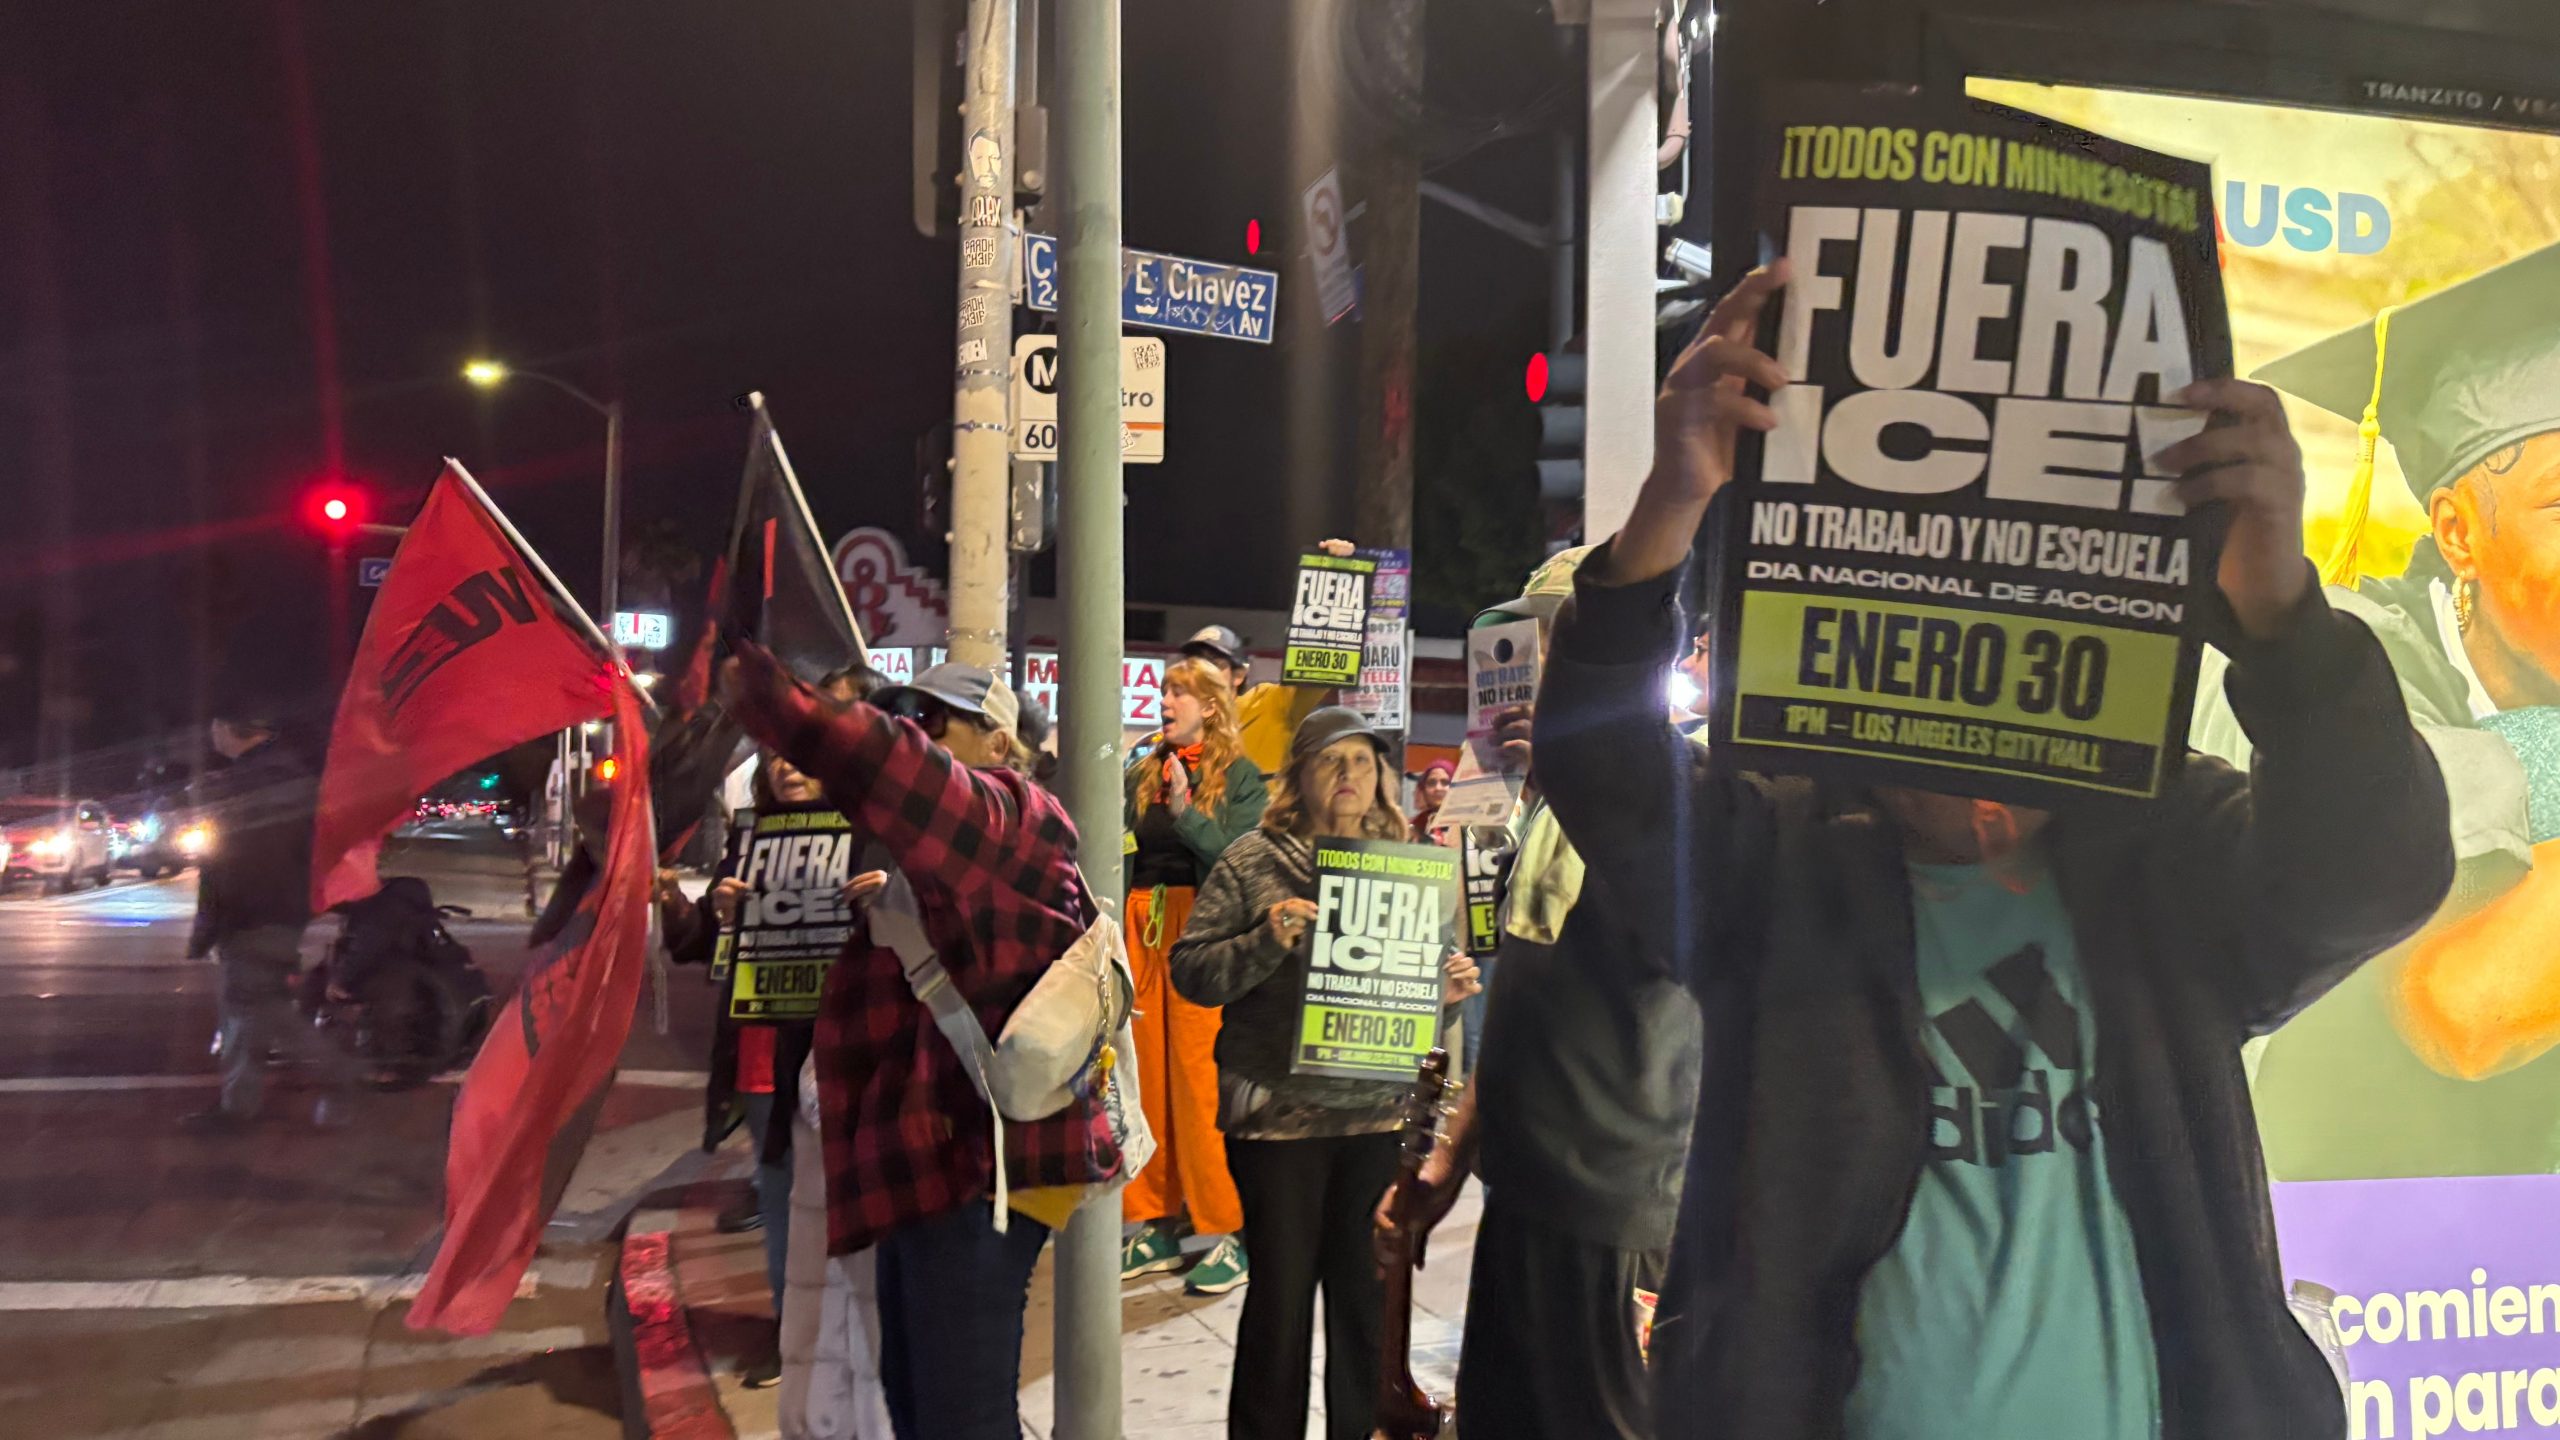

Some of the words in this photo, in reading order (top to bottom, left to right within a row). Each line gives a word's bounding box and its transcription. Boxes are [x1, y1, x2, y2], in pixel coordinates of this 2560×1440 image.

[2363, 81, 2483, 109] TRANZITO
[1780, 125, 1917, 180] ¡TODOS
[1920, 130, 2000, 188] CON
[2214, 180, 2392, 255] USD
[1168, 262, 1267, 312] Chavez
[1776, 206, 2195, 403] FUERA
[1238, 310, 1264, 337] Av
[1760, 382, 2210, 517] ICE!
[1749, 501, 1798, 546] NO
[1803, 504, 1952, 559] TRABAJO
[1958, 516, 1982, 561] Y
[1982, 519, 2033, 567] NO
[2034, 525, 2191, 586] ESCUELA
[1298, 569, 1366, 609] FUERA
[1747, 561, 1804, 581] DIA
[1808, 565, 1983, 598] NACIONAL
[1988, 581, 2039, 603] DE
[2038, 588, 2184, 623] ACCION
[1292, 604, 1366, 631] ICE!
[1296, 650, 1331, 670] ENERO
[1331, 652, 1348, 670] 30
[1797, 605, 2009, 707] ENERO
[2016, 629, 2111, 721] 30
[1478, 687, 1496, 706] NO
[1499, 684, 1533, 703] FEAR
[1853, 710, 1895, 742] LOS
[1895, 716, 1995, 756] ANGELES
[1995, 730, 2049, 763] CITY
[748, 833, 852, 892] FUERA
[1316, 875, 1440, 944] FUERA
[755, 964, 817, 997] ENERO
[1311, 931, 1443, 979] ICE!
[1325, 973, 1373, 995] TRABAJO
[1372, 978, 1380, 995] Y
[1395, 981, 1438, 1001] ESCUELA
[1323, 1010, 1387, 1046] ENERO
[1389, 1018, 1416, 1048] 30
[2329, 1267, 2560, 1346] comien
[2410, 1366, 2560, 1440] para
